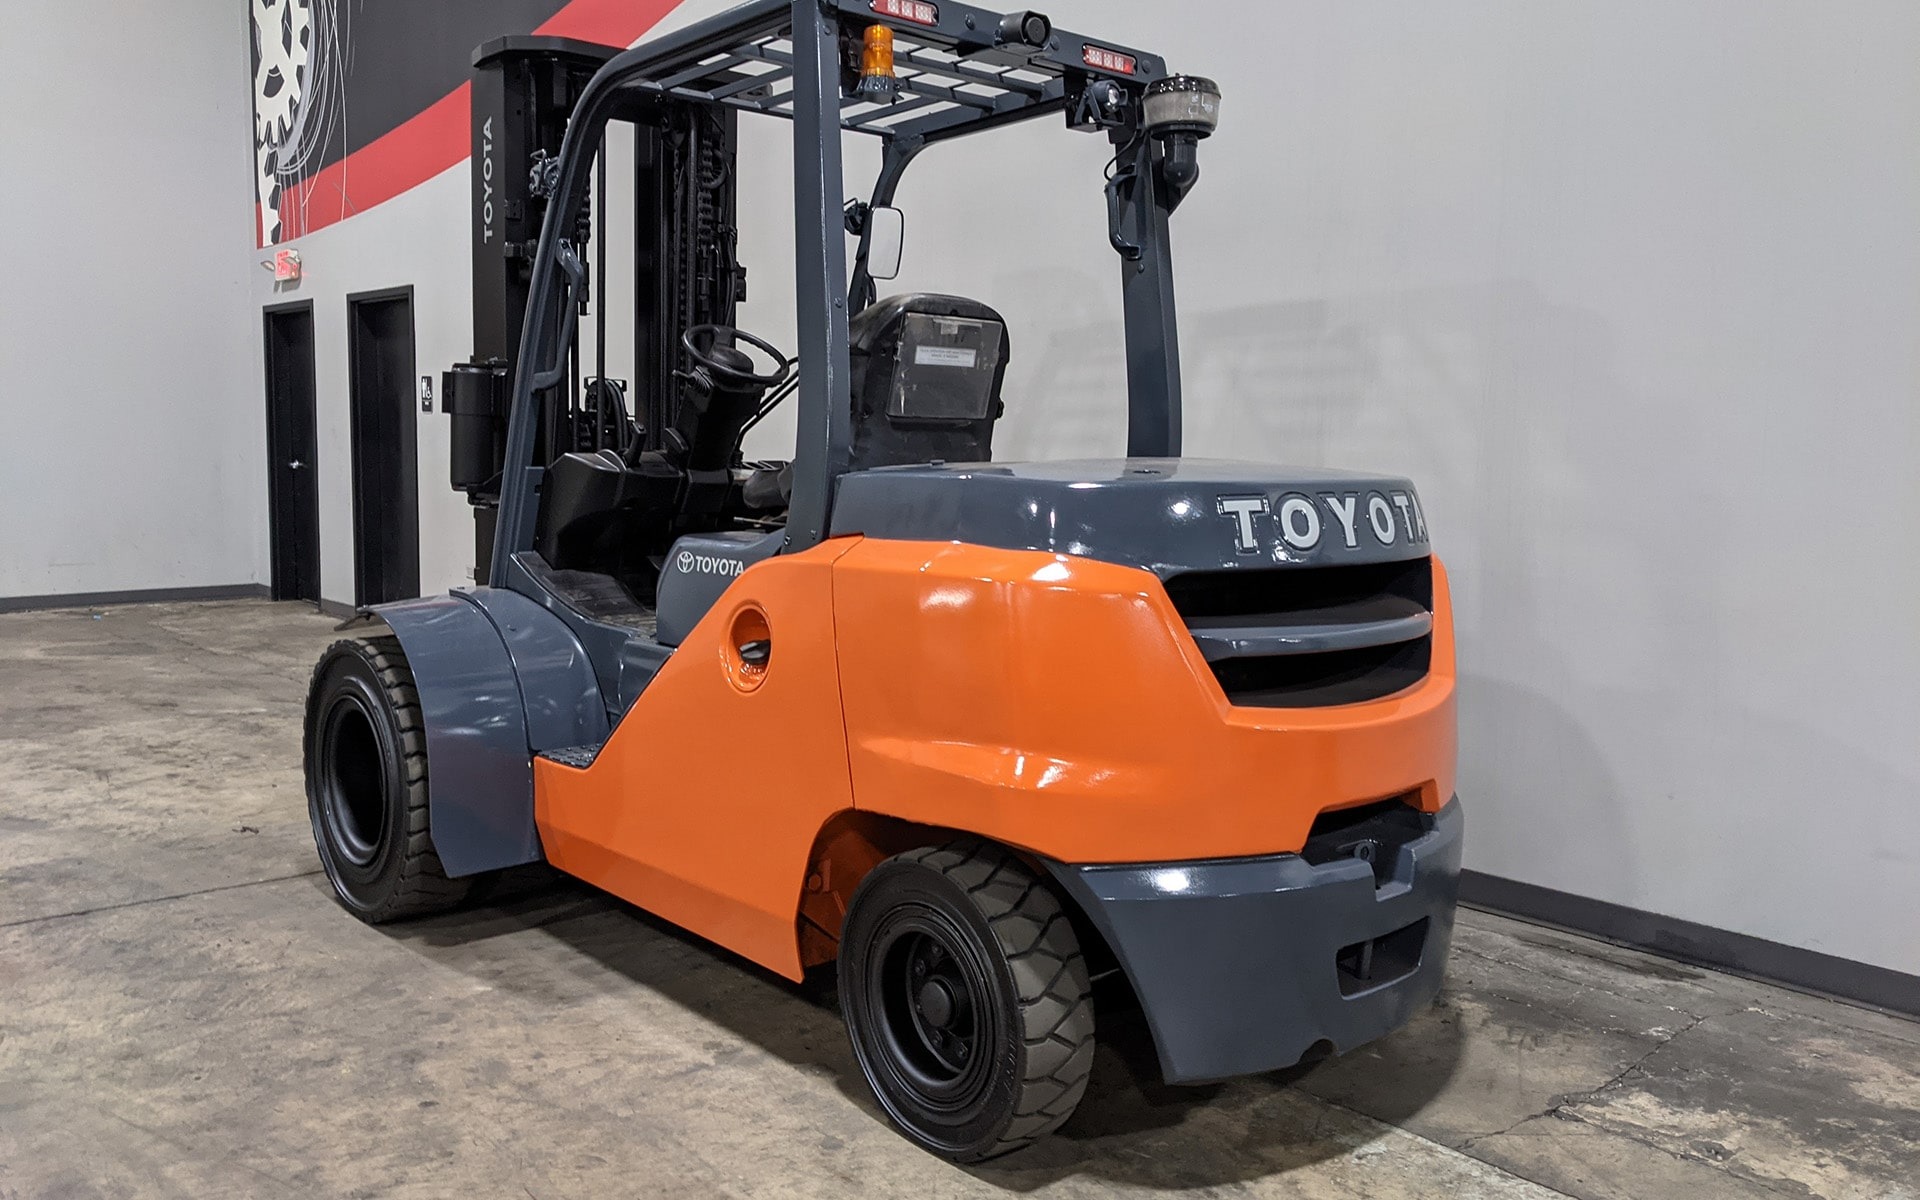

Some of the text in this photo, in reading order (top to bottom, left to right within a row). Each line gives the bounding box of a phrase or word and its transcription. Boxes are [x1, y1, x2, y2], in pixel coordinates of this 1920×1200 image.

[483, 115, 493, 244] TOYOTA
[1218, 491, 1428, 553] TOYOTA
[695, 555, 745, 577] TOYOTA
